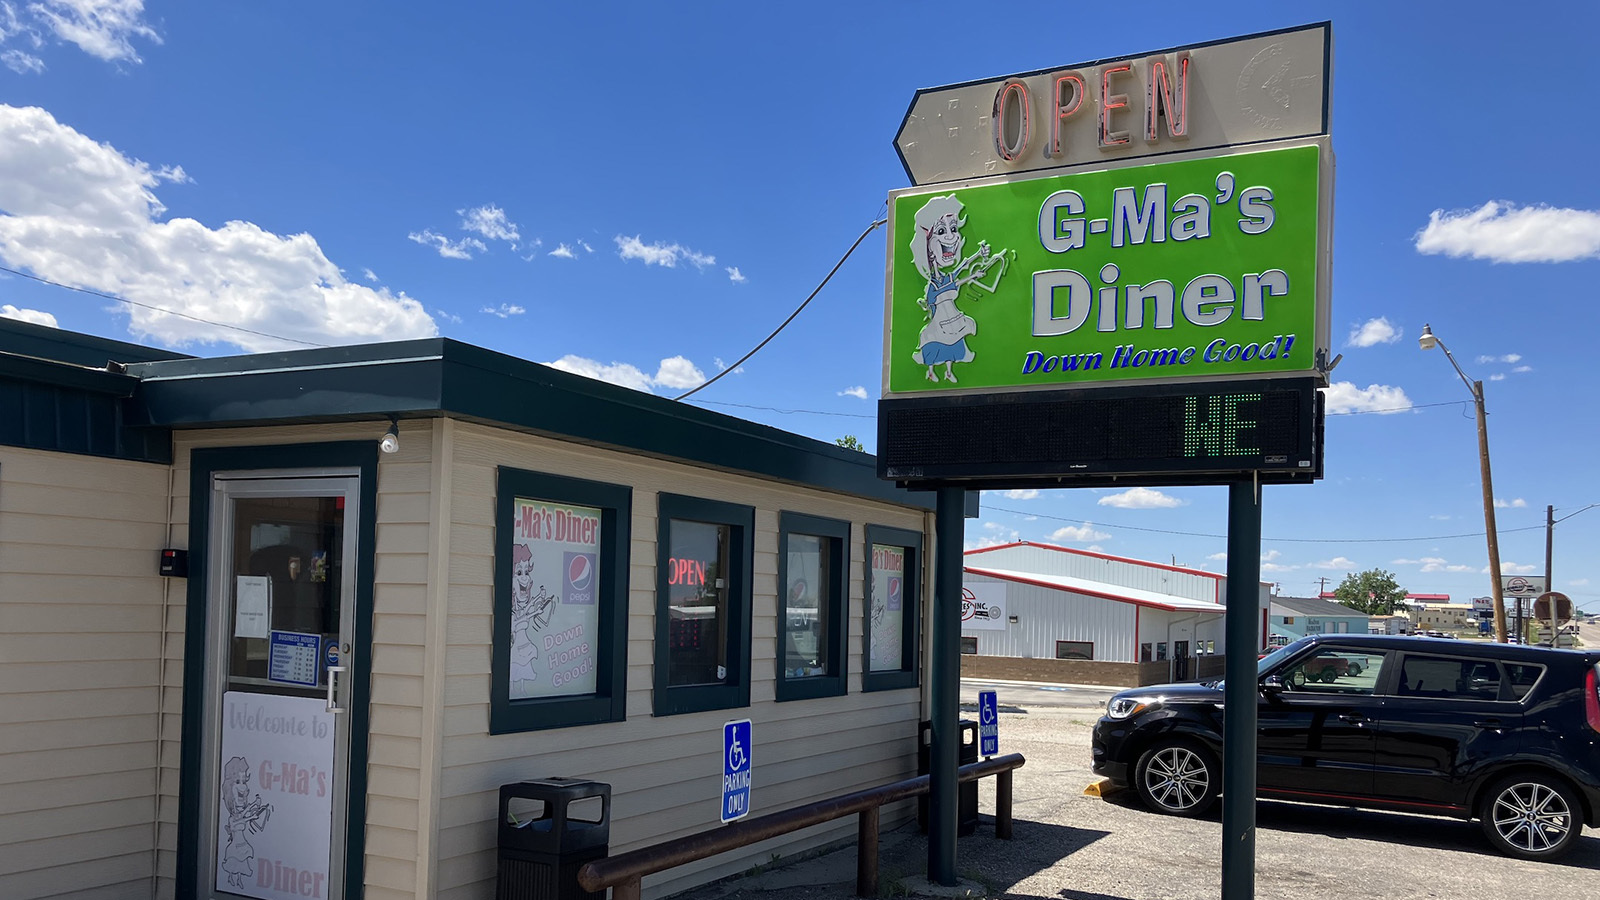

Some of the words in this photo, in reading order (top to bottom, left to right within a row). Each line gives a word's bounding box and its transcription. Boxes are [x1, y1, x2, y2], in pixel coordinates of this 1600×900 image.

[992, 50, 1192, 162] OPEN
[1037, 171, 1276, 254] G-Ma's
[1031, 263, 1289, 337] Diner
[1022, 349, 1103, 375] Down
[1109, 342, 1195, 369] Home
[1203, 334, 1296, 363] Good!
[1183, 393, 1261, 457] WE
[514, 506, 552, 541] -Ma's
[555, 509, 598, 545] Diner
[668, 557, 705, 586] OPEN
[569, 591, 591, 603] pepsi
[278, 634, 300, 642] BUSINESS
[543, 624, 584, 652] Down
[548, 641, 590, 670] Home
[552, 656, 594, 688] Good!
[229, 702, 306, 737] Welcome
[312, 714, 328, 740] to
[258, 759, 326, 798] G-Ma's
[724, 769, 750, 793] PARKING
[728, 792, 745, 814] ONLY
[256, 857, 324, 899] Diner
